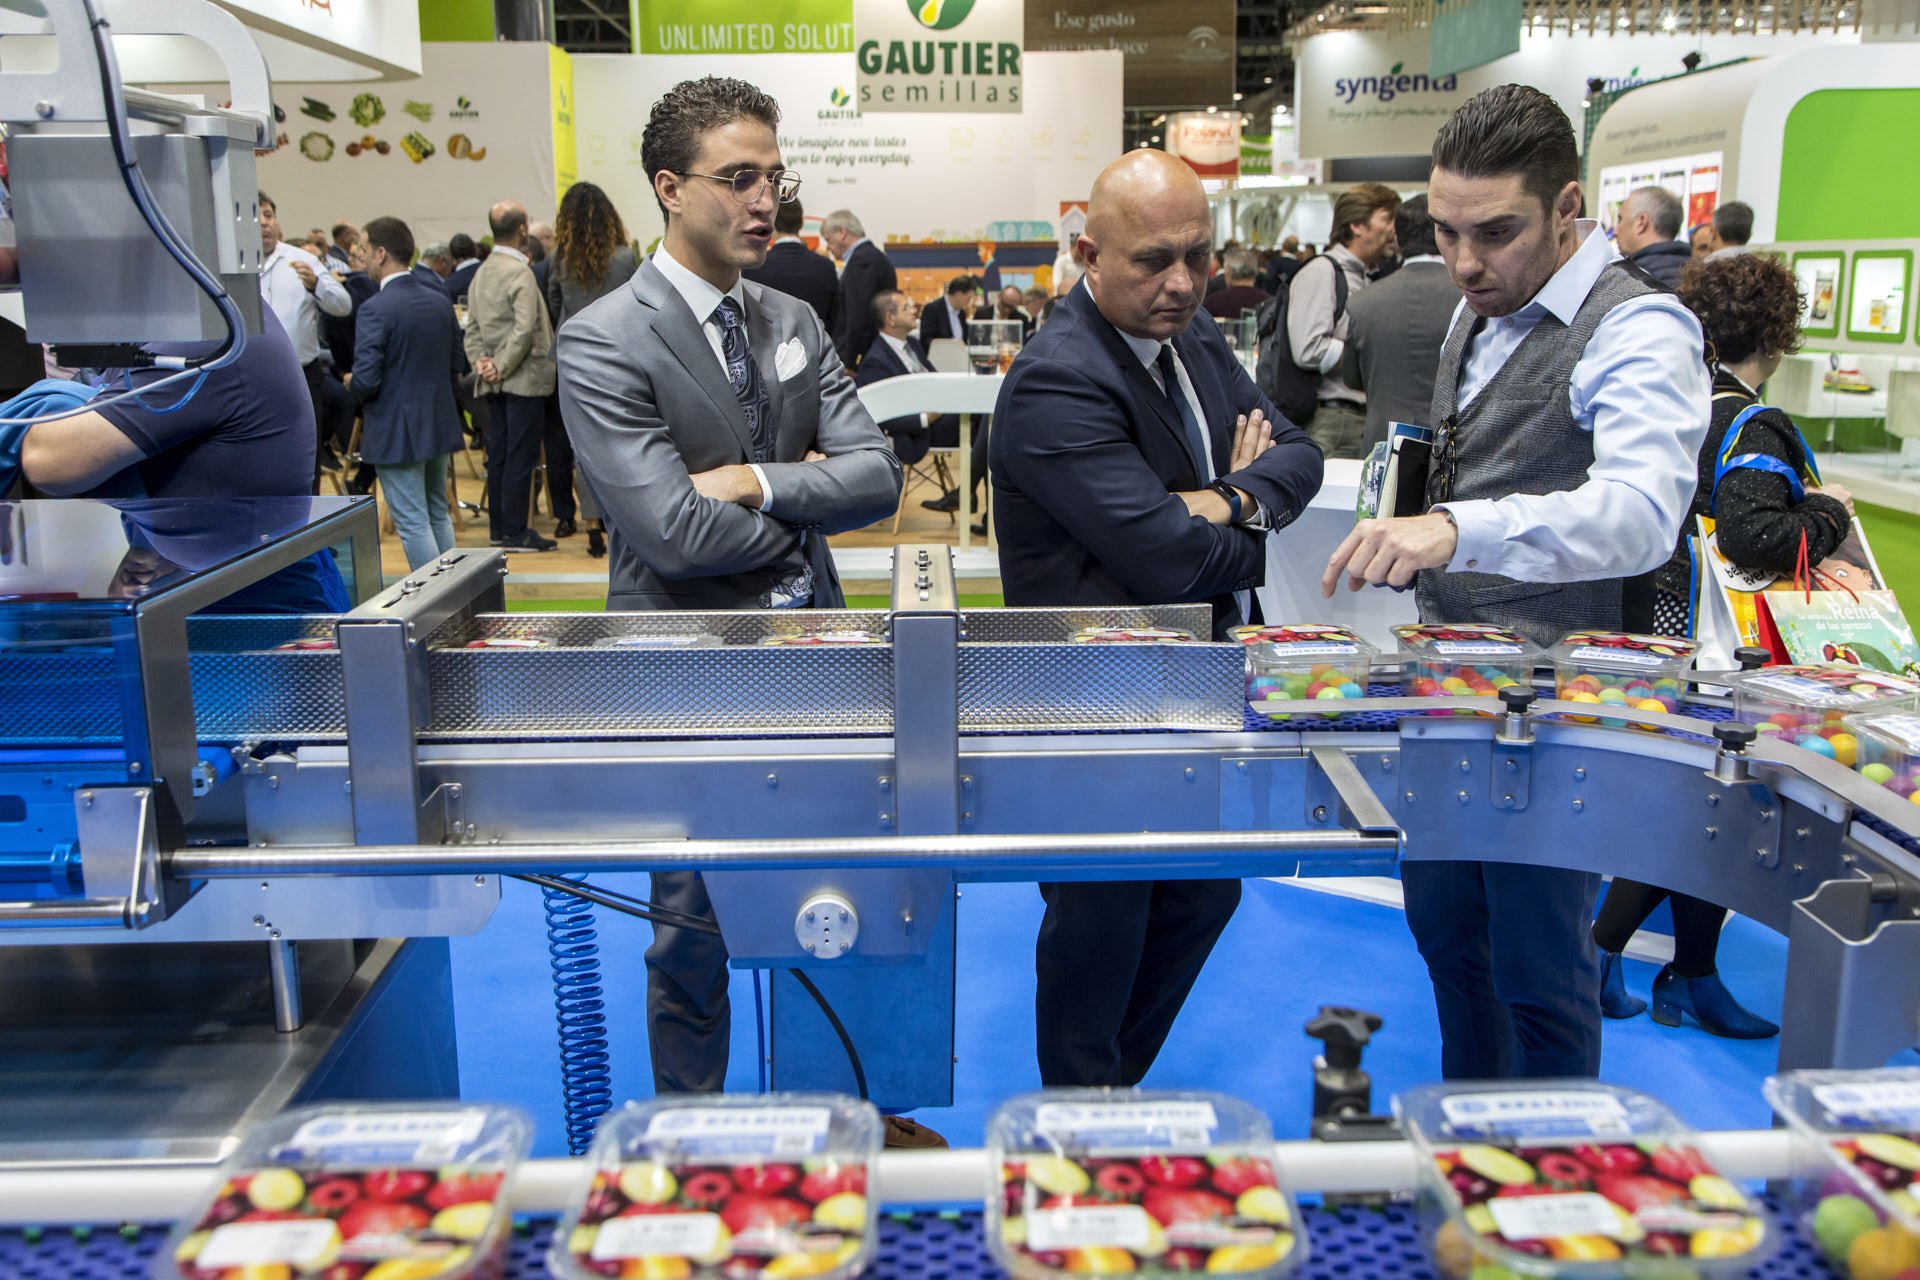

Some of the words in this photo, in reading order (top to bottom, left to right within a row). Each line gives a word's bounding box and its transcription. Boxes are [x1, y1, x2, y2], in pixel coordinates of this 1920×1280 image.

[1054, 11, 1085, 29] Ese
[1089, 12, 1136, 33] gusto
[659, 24, 775, 50] UNLIMITED
[858, 40, 1022, 75] GAUTIER
[861, 80, 1020, 102] semillas
[798, 136, 845, 150] imagine
[874, 136, 906, 147] tastes
[786, 155, 808, 167] you
[825, 153, 856, 167] enjoy
[1831, 603, 1879, 620] Reina
